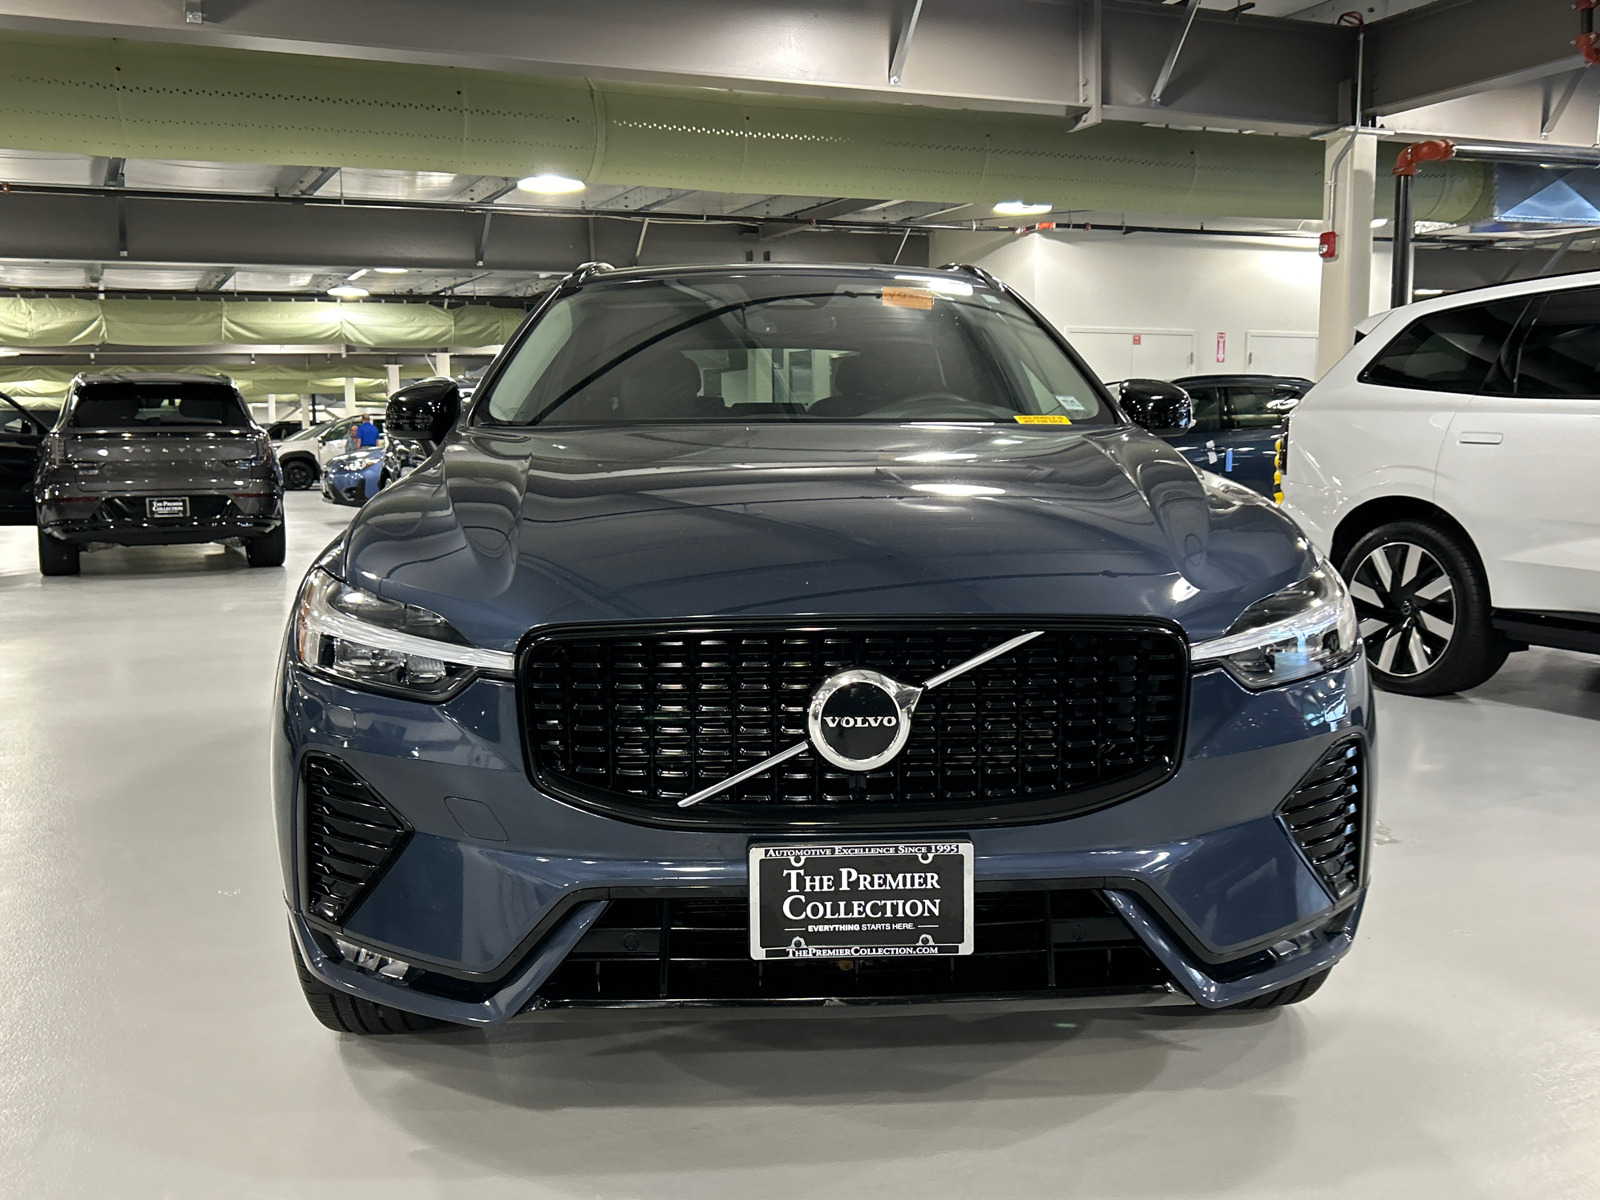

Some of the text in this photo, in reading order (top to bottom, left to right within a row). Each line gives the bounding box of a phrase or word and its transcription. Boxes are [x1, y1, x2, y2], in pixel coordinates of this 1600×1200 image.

[823, 716, 897, 728] VOLVO
[766, 844, 958, 857] AUTOMOTIVE EXCELLENCE SINCE 1995
[783, 867, 941, 893] THE PREMIER
[782, 895, 941, 920] COLLECTION
[808, 922, 916, 932] EVERYTHING STARTS HERE.
